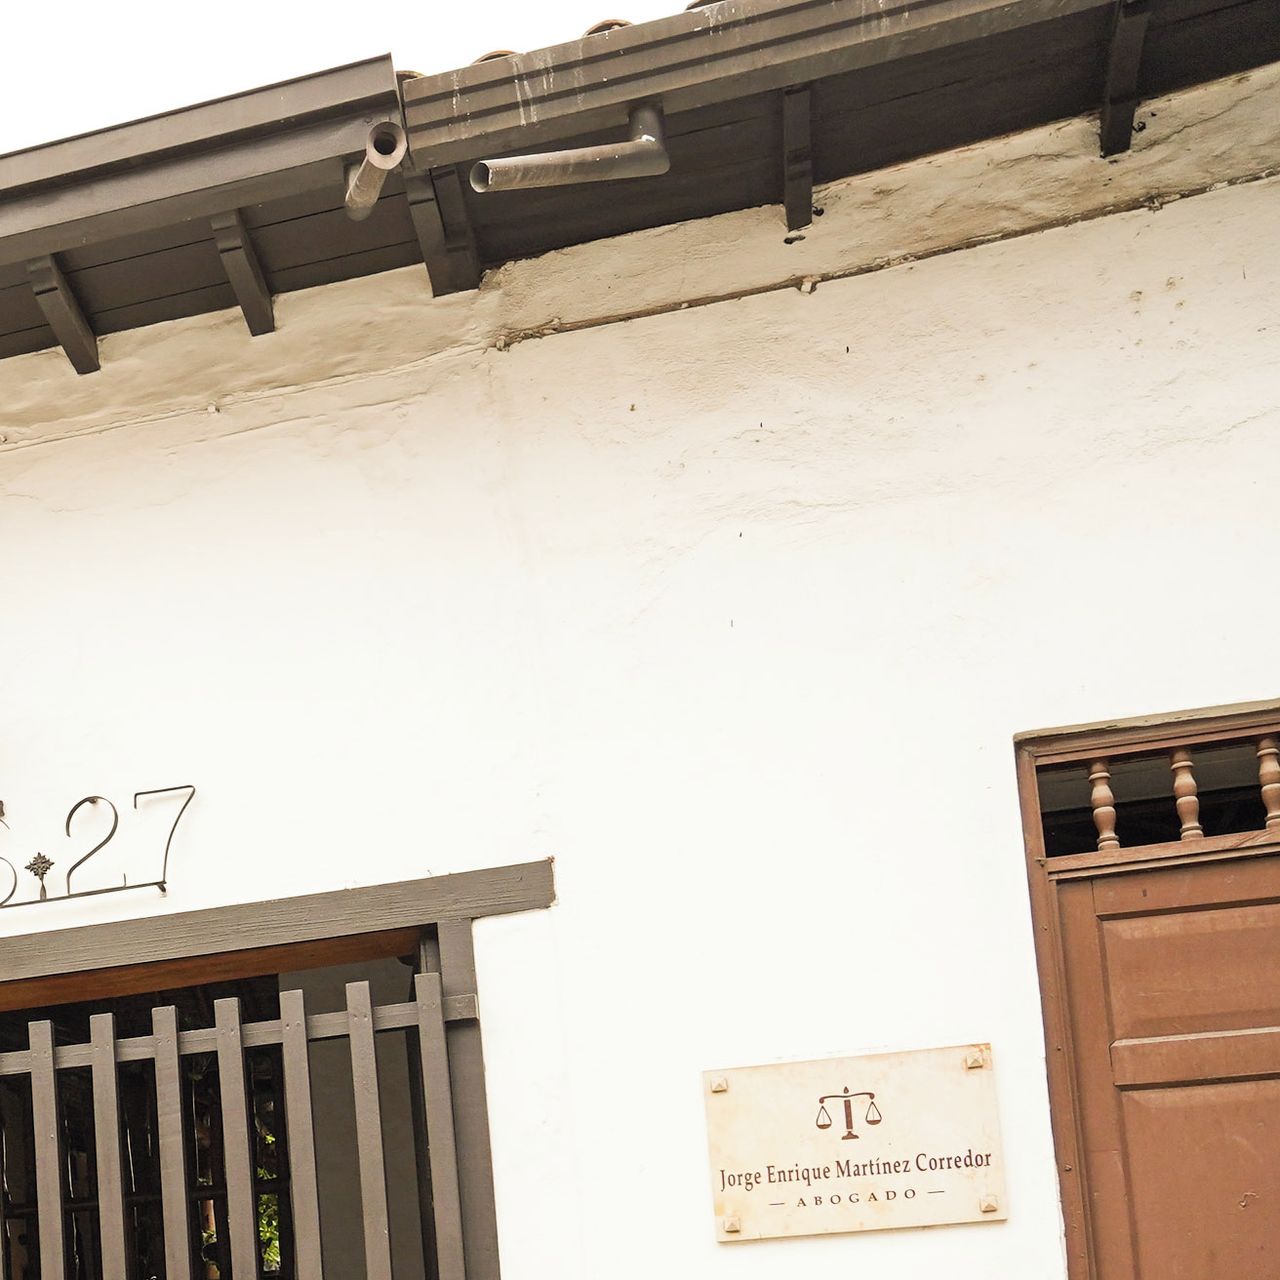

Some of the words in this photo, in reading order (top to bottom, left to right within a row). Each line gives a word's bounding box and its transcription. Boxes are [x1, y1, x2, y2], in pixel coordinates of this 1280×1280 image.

[720, 1168, 762, 1192] Jorge
[766, 1164, 831, 1187] Enrique
[835, 1156, 911, 1178] Martínez
[915, 1148, 992, 1172] Corredor
[796, 1188, 916, 1208] ABOGADO
